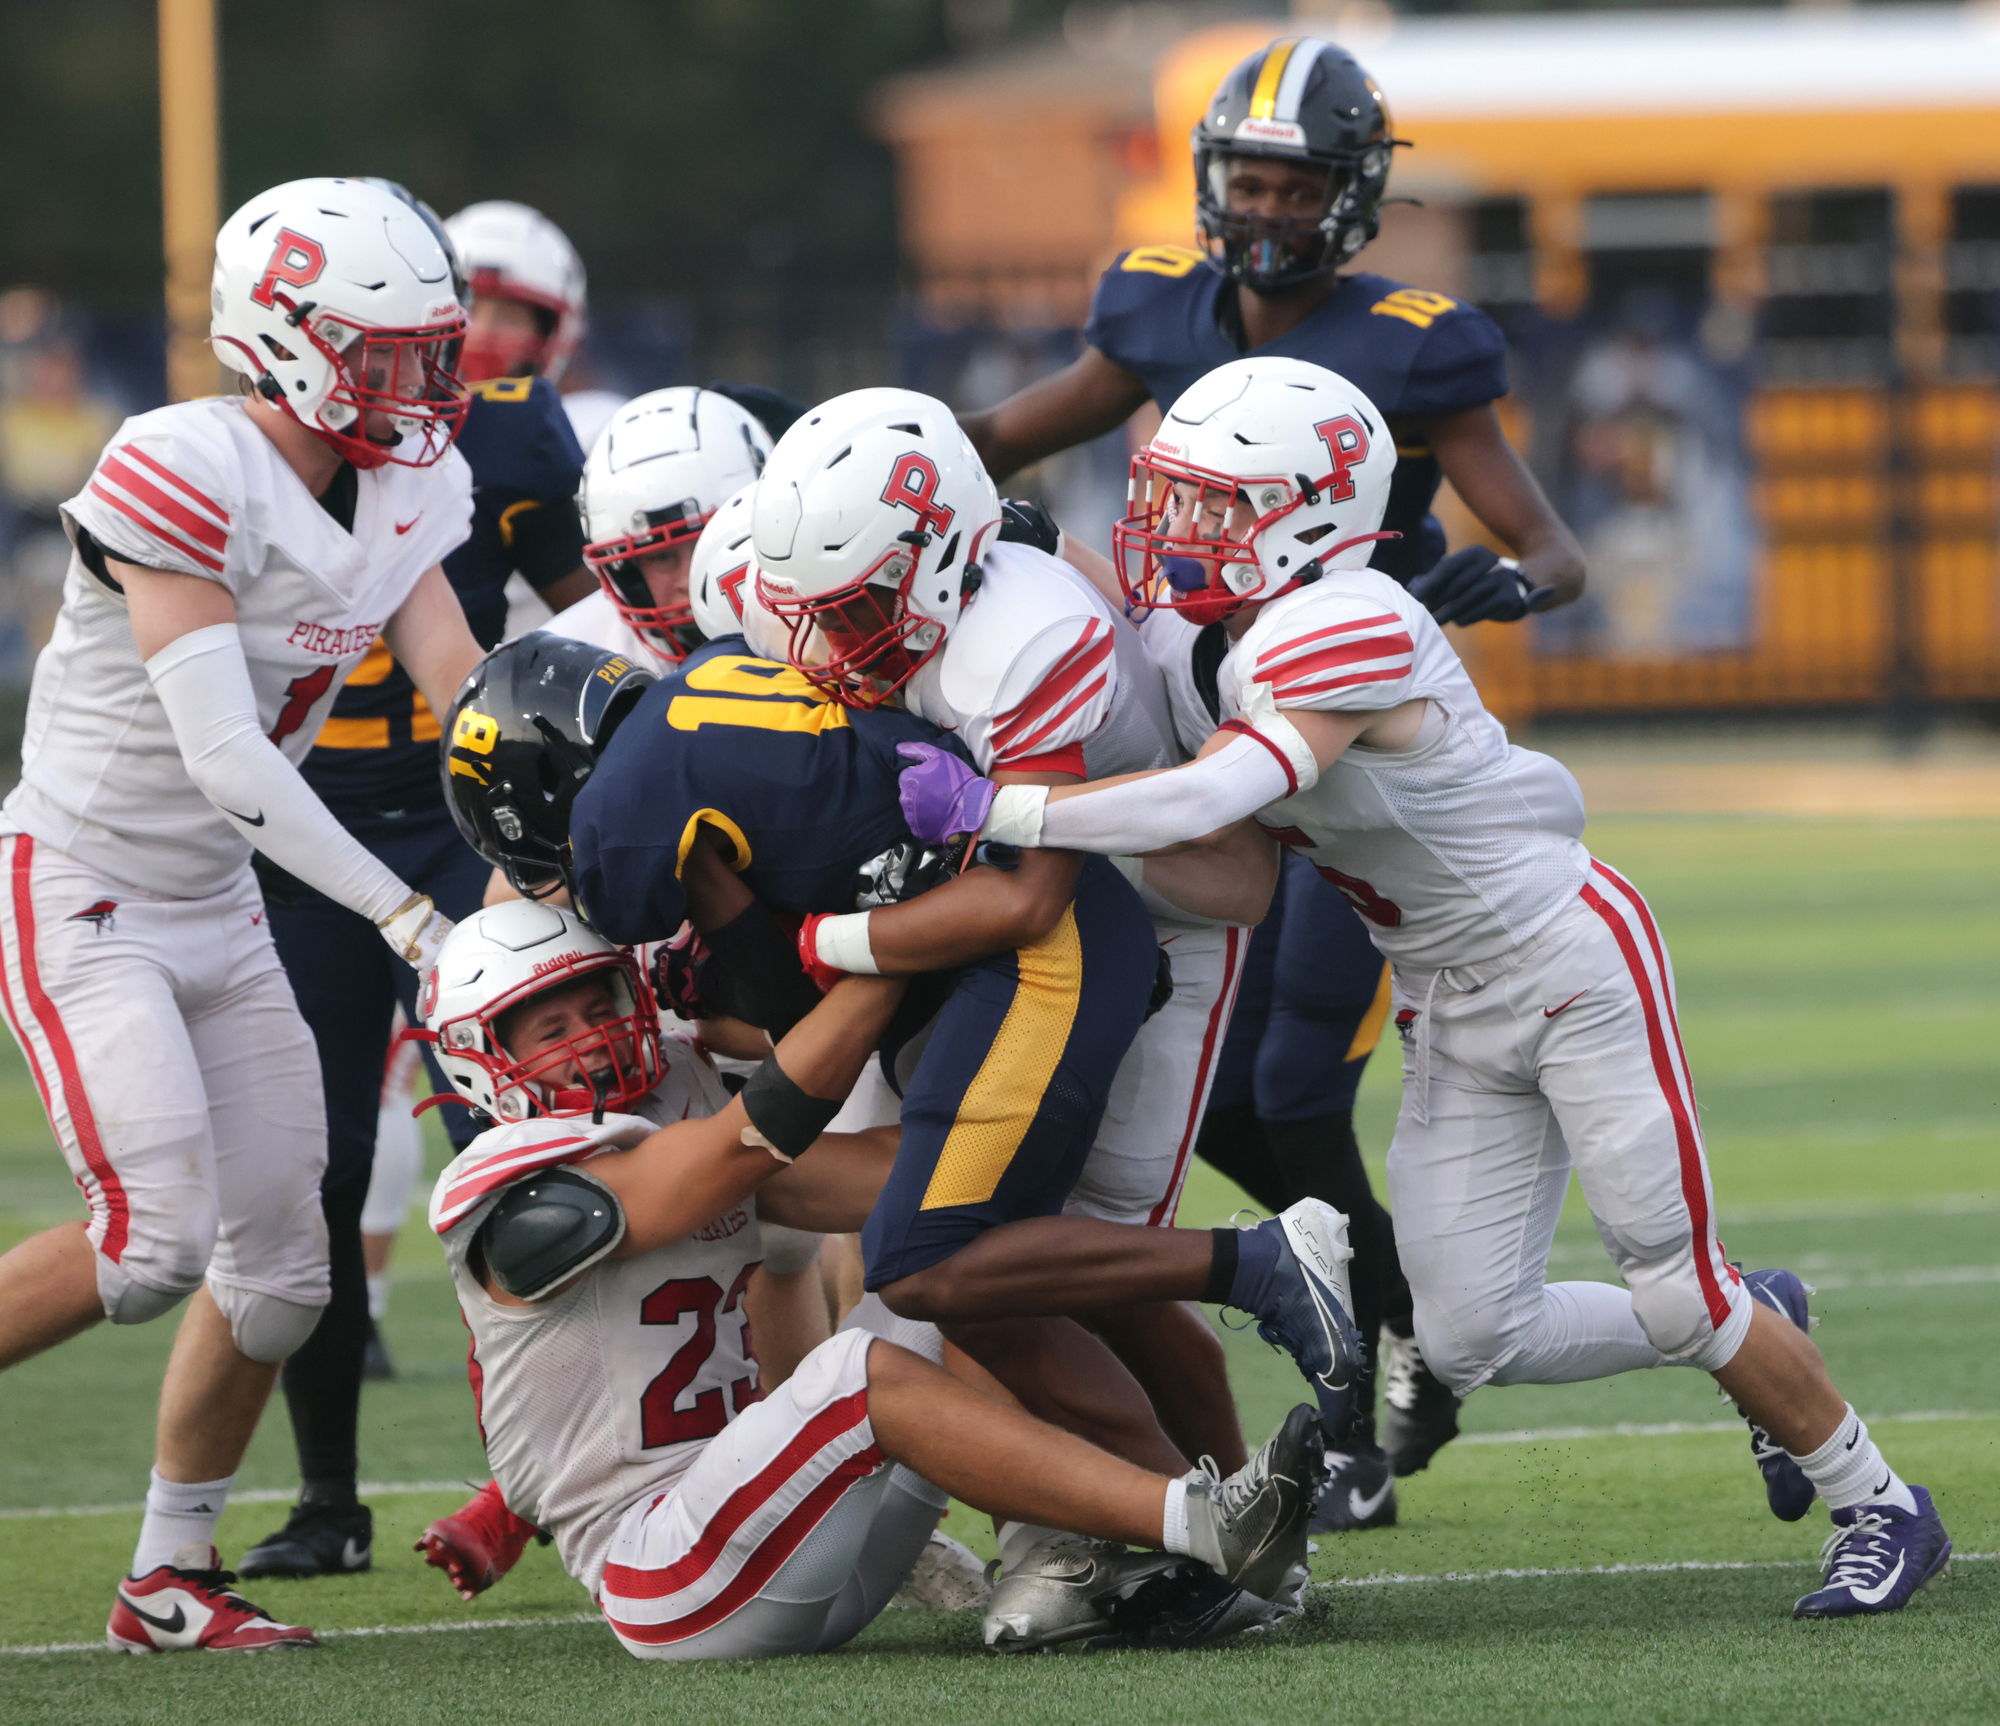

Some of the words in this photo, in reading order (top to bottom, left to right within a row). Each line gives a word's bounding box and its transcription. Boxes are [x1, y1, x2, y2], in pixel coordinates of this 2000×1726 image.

[251, 226, 327, 311] P
[1371, 288, 1457, 329] 10
[879, 451, 956, 540] P
[1313, 414, 1370, 505] P
[286, 621, 382, 655] PIRATES
[449, 708, 499, 786] 18
[640, 1259, 767, 1450] 23
